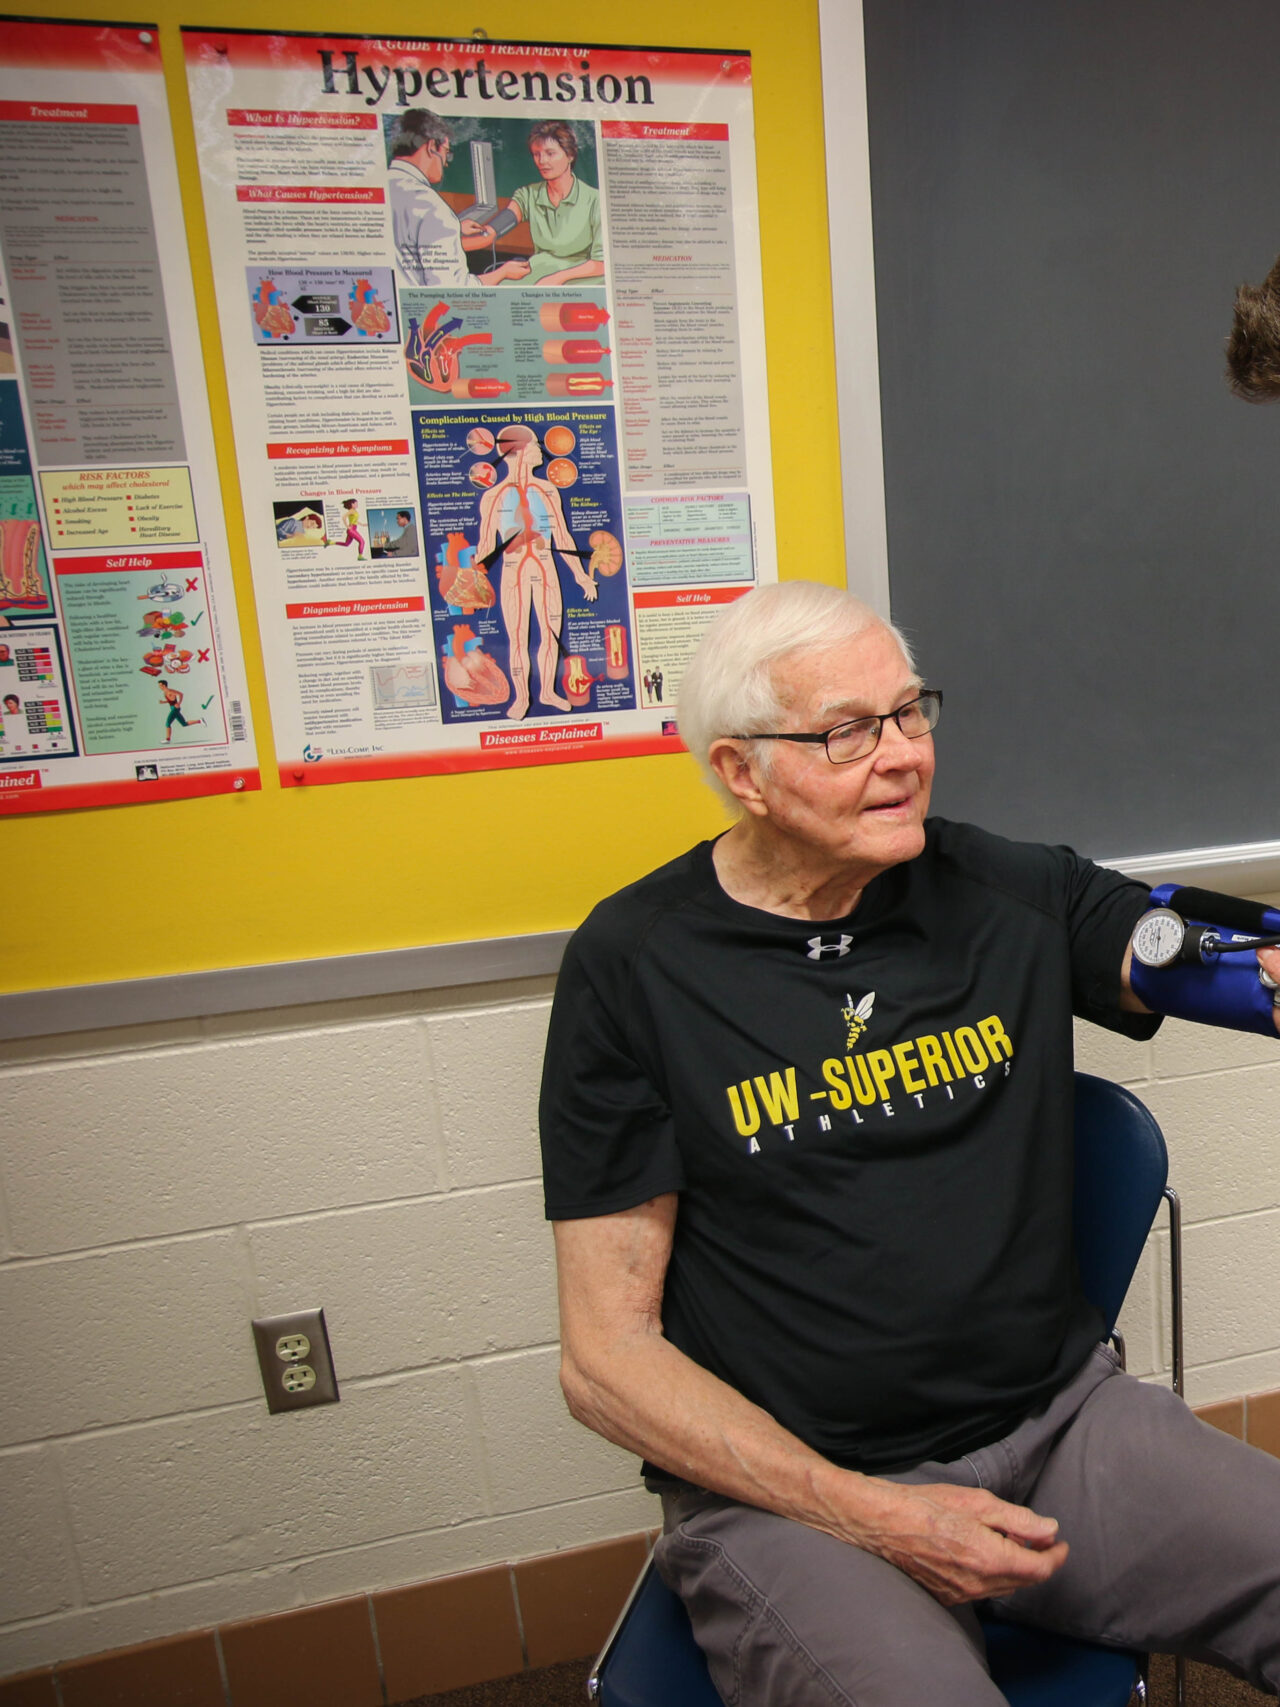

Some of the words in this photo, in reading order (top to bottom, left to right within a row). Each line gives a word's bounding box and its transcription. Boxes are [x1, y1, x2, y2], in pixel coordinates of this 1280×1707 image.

[491, 45, 567, 57] TREATMENT
[573, 48, 590, 58] OF
[318, 50, 655, 106] Hypertension
[30, 106, 88, 118] Treatment
[246, 113, 273, 123] What
[275, 113, 285, 123] Is
[288, 114, 360, 126] Hypertension?
[643, 125, 690, 136] Treatment
[248, 189, 273, 198] What
[275, 190, 307, 199] Causes
[309, 190, 374, 201] Hypertension?
[419, 415, 479, 425] Complications
[481, 413, 511, 423] Caused
[512, 413, 522, 424] by
[524, 412, 545, 423] High
[546, 412, 570, 421] Blood
[572, 411, 606, 420] Pressure
[286, 446, 335, 456] Recognizing
[351, 444, 393, 453] Symptoms
[79, 472, 103, 481] RISK
[105, 471, 151, 480] FACTORS
[129, 480, 170, 488] cholesterol
[106, 558, 127, 569] Self
[128, 557, 152, 568] Help
[676, 594, 692, 602] Self
[693, 594, 711, 603] Help
[303, 604, 351, 615] Diagnosing
[353, 600, 409, 612] Hypertension
[485, 731, 537, 746] Diseases
[540, 726, 598, 742] Explained
[748, 1061, 1011, 1154] ATHLETICS
